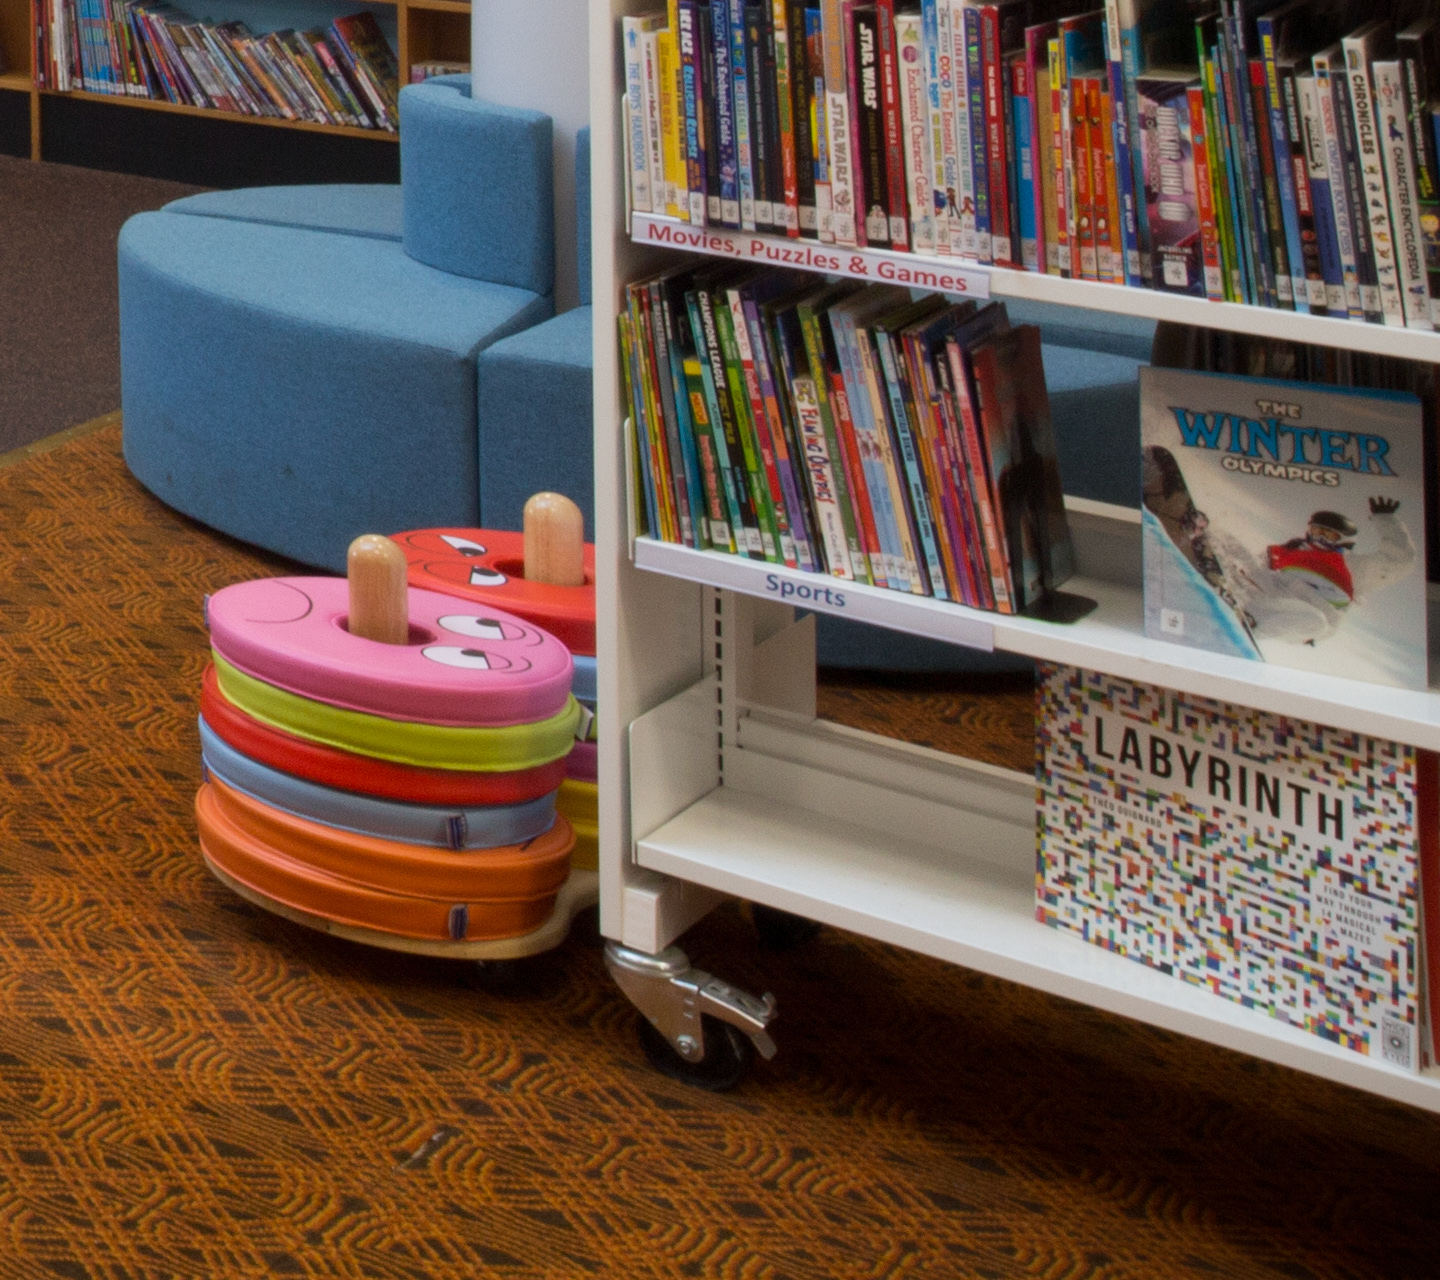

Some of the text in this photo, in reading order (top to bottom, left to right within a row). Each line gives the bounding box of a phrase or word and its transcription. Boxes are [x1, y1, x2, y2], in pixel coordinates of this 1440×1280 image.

[679, 8, 692, 31] ICE
[711, 0, 727, 40] FROZEN
[715, 46, 728, 65] The
[858, 22, 878, 110] STAR WARS
[1261, 34, 1283, 110] MAZE ADVENTURE
[628, 61, 648, 172] THE BOYS' HANDBOOK
[718, 117, 733, 146] Guide
[906, 67, 928, 207] Enchanted Character Guide
[938, 55, 959, 187] COCO The Essential Guide
[1349, 73, 1377, 156] CHRONICLES
[830, 97, 850, 186] STAR WARS
[1155, 105, 1187, 198] DOCTOR WHO
[1324, 138, 1344, 188] COMPLETE
[1292, 157, 1310, 213] OFFICIAL GUIDE
[1332, 188, 1348, 217] BOOK
[1337, 217, 1349, 228] OF
[1389, 145, 1424, 282] CHARACTER ENCYCLOPEDIA
[648, 224, 967, 291] Movies, Puzzles & Games
[656, 308, 669, 359] BASKETBALL
[698, 291, 726, 389] CHAMPIONS LEAGUE
[709, 402, 723, 430] PLAYERS
[796, 405, 828, 456] FLAMING
[890, 396, 917, 463] MOUNTAIN BIKING
[1256, 399, 1302, 419] THE
[1168, 406, 1399, 477] WINTER
[806, 451, 840, 507] OLYMPICS
[1222, 456, 1339, 486] OLYMPICS
[766, 574, 845, 607] Sports
[1095, 716, 1345, 841] LABYRINTH
[1117, 803, 1162, 829] GUIGNARD
[1316, 894, 1381, 924] WAY THROUGH
[1321, 909, 1377, 936] 14 MAGICAL
[1324, 885, 1373, 910] FIND YOUR
[1340, 927, 1371, 946] MAZES
